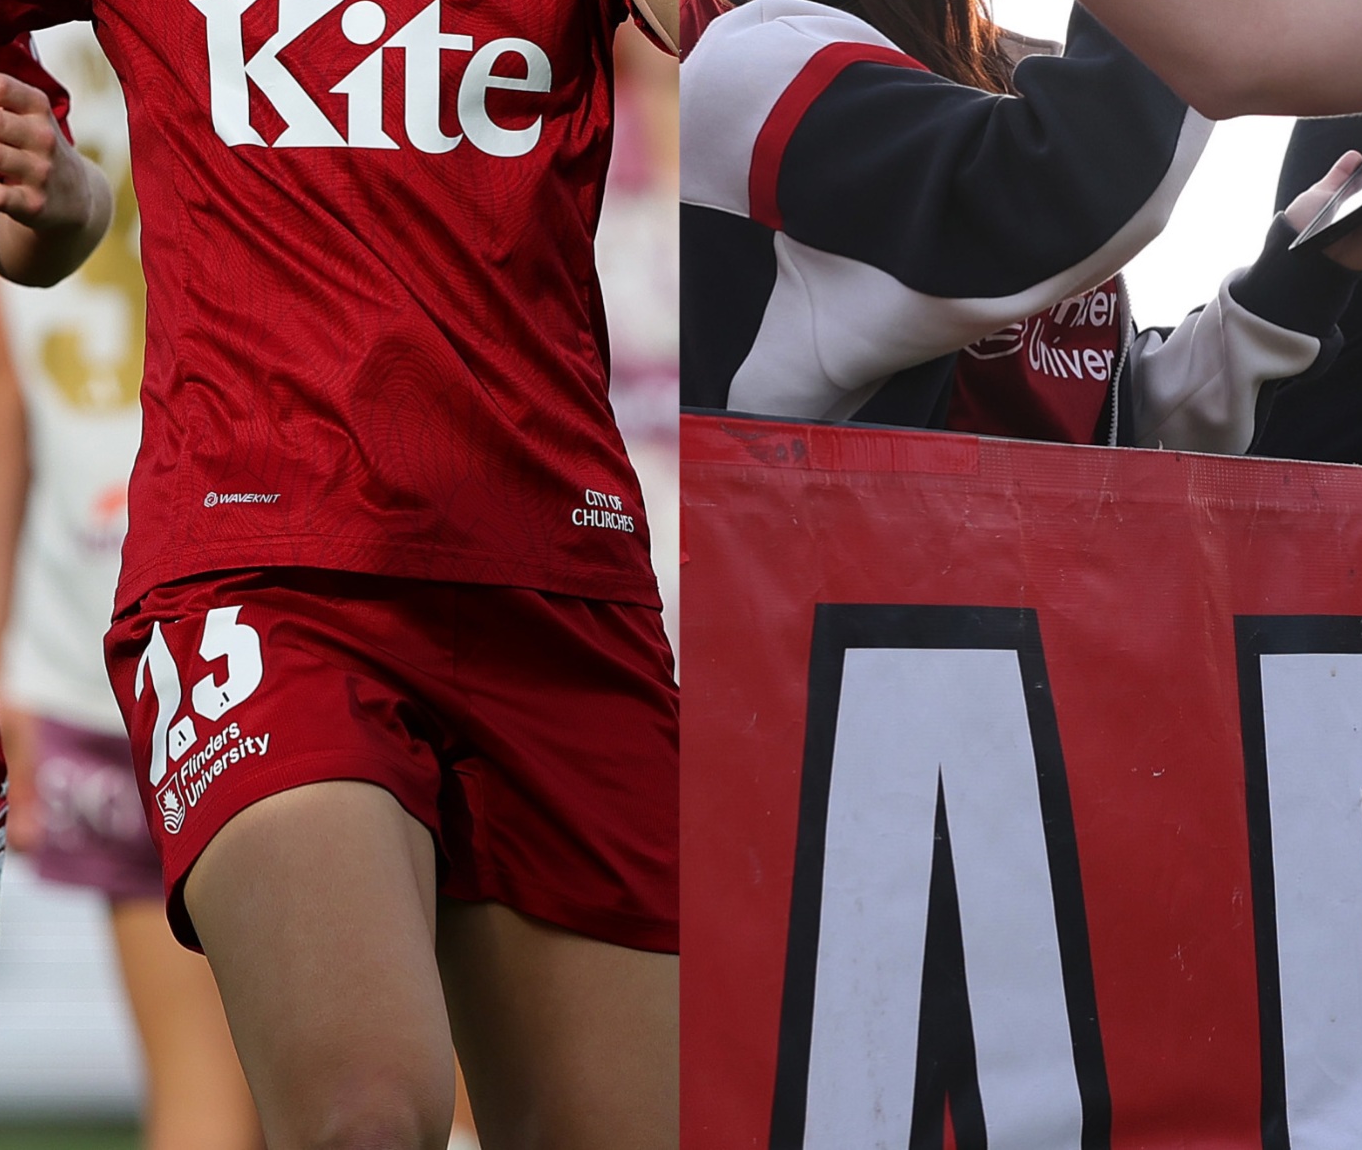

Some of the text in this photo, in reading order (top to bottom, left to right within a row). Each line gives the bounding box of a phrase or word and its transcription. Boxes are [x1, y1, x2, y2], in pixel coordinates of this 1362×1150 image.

[219, 492, 282, 504] WAVEKNIT
[585, 488, 623, 512] CITY OF
[571, 508, 635, 533] CHURCHES
[180, 721, 241, 786] Flinders
[185, 733, 270, 808] University
